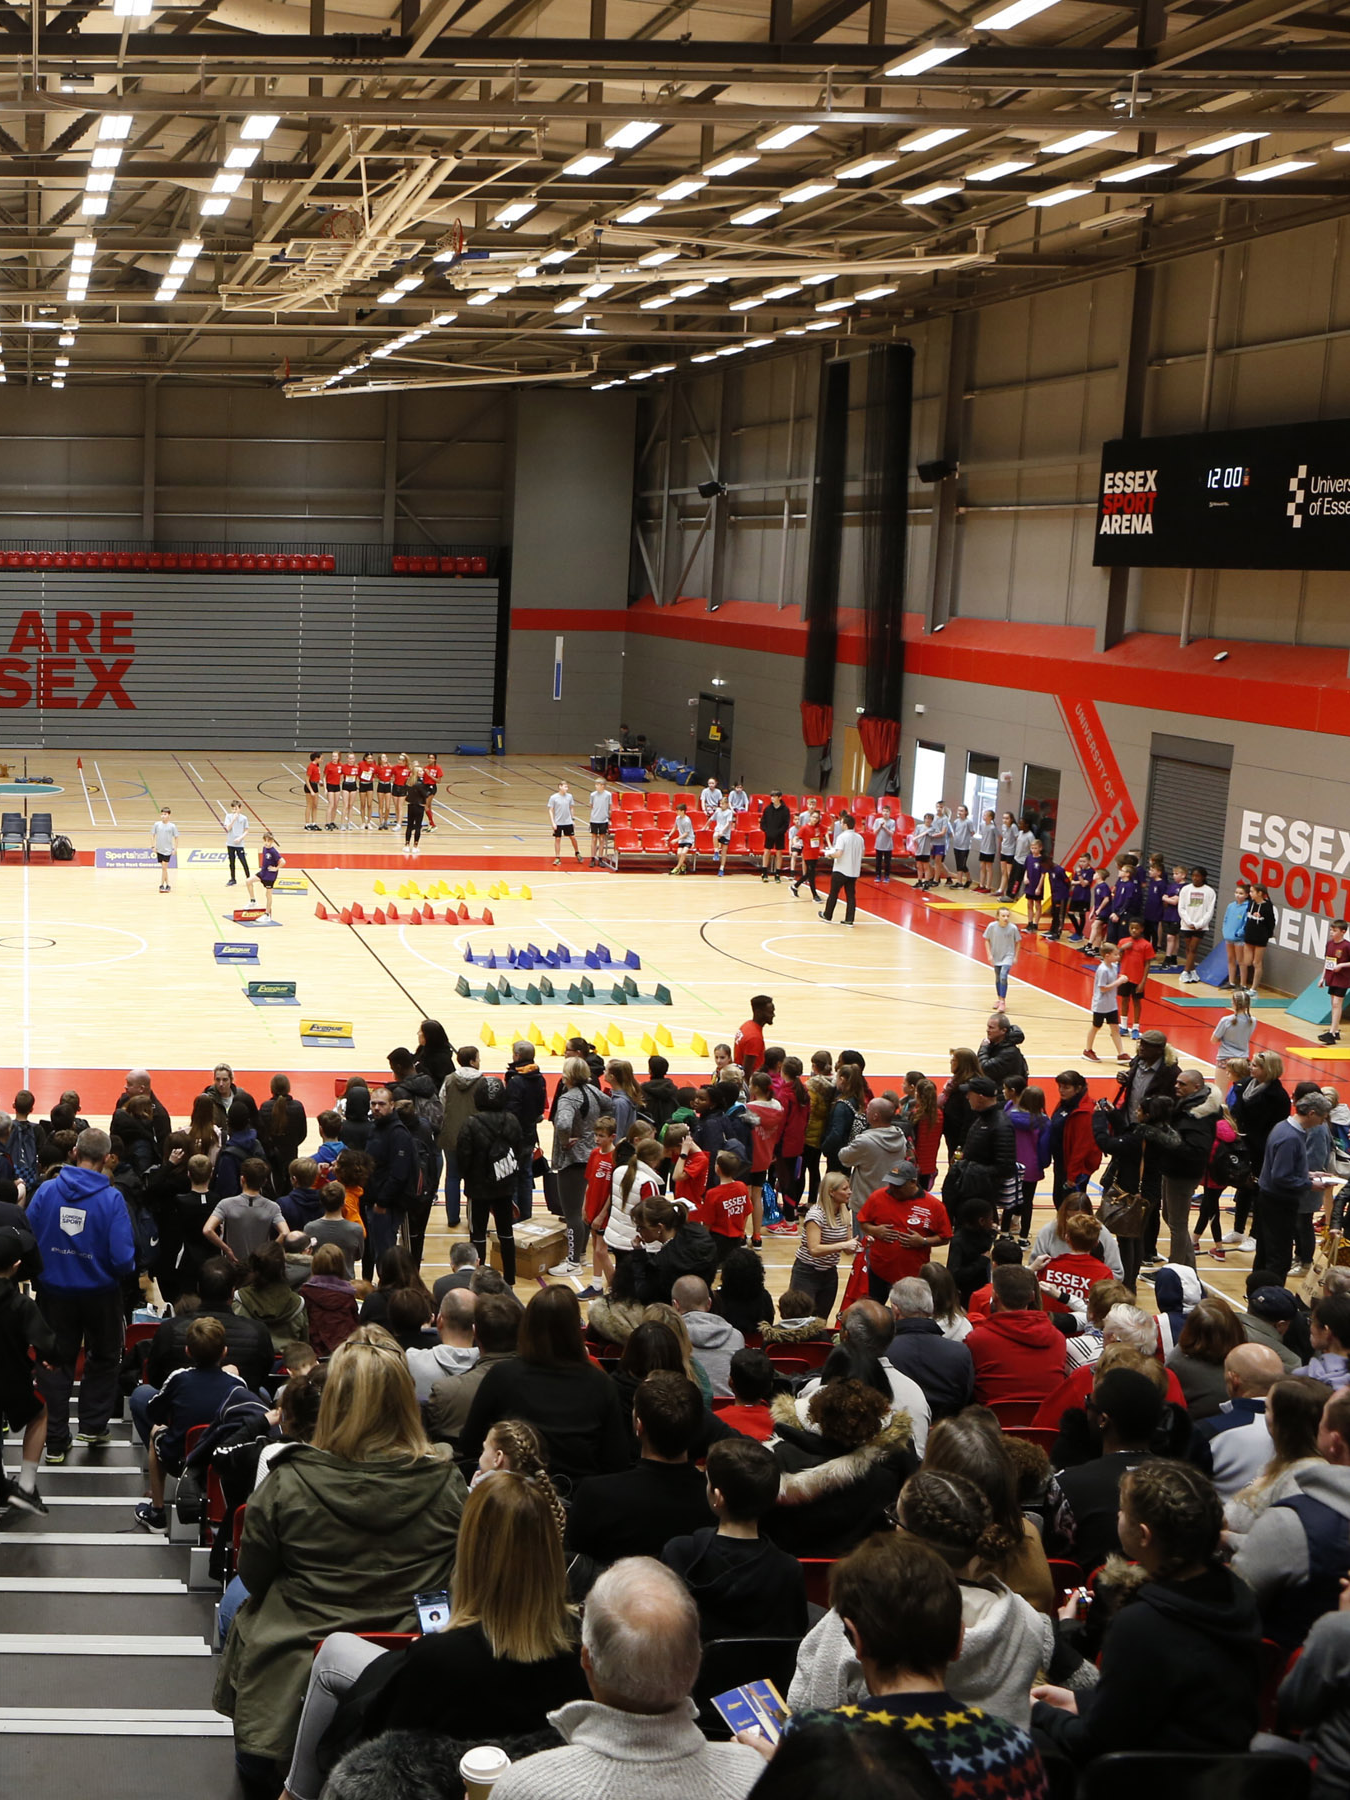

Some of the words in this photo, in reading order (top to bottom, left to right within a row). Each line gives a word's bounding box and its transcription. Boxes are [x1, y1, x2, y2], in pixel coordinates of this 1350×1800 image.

[1103, 470, 1158, 494] ESSEX
[1102, 491, 1158, 514] SPORT
[1309, 498, 1323, 515] of
[1099, 513, 1154, 535] ARENA
[7, 610, 136, 654] ARE
[1074, 703, 1108, 780] UNIVERSITY
[1103, 781, 1115, 800] OF
[1240, 810, 1350, 875] ESSEX
[105, 850, 158, 860] Sportshall.o
[187, 849, 247, 863] Eveq
[722, 1195, 747, 1210] ESSEX
[62, 1213, 83, 1221] LONDON
[1046, 1269, 1091, 1290] ESSEX
